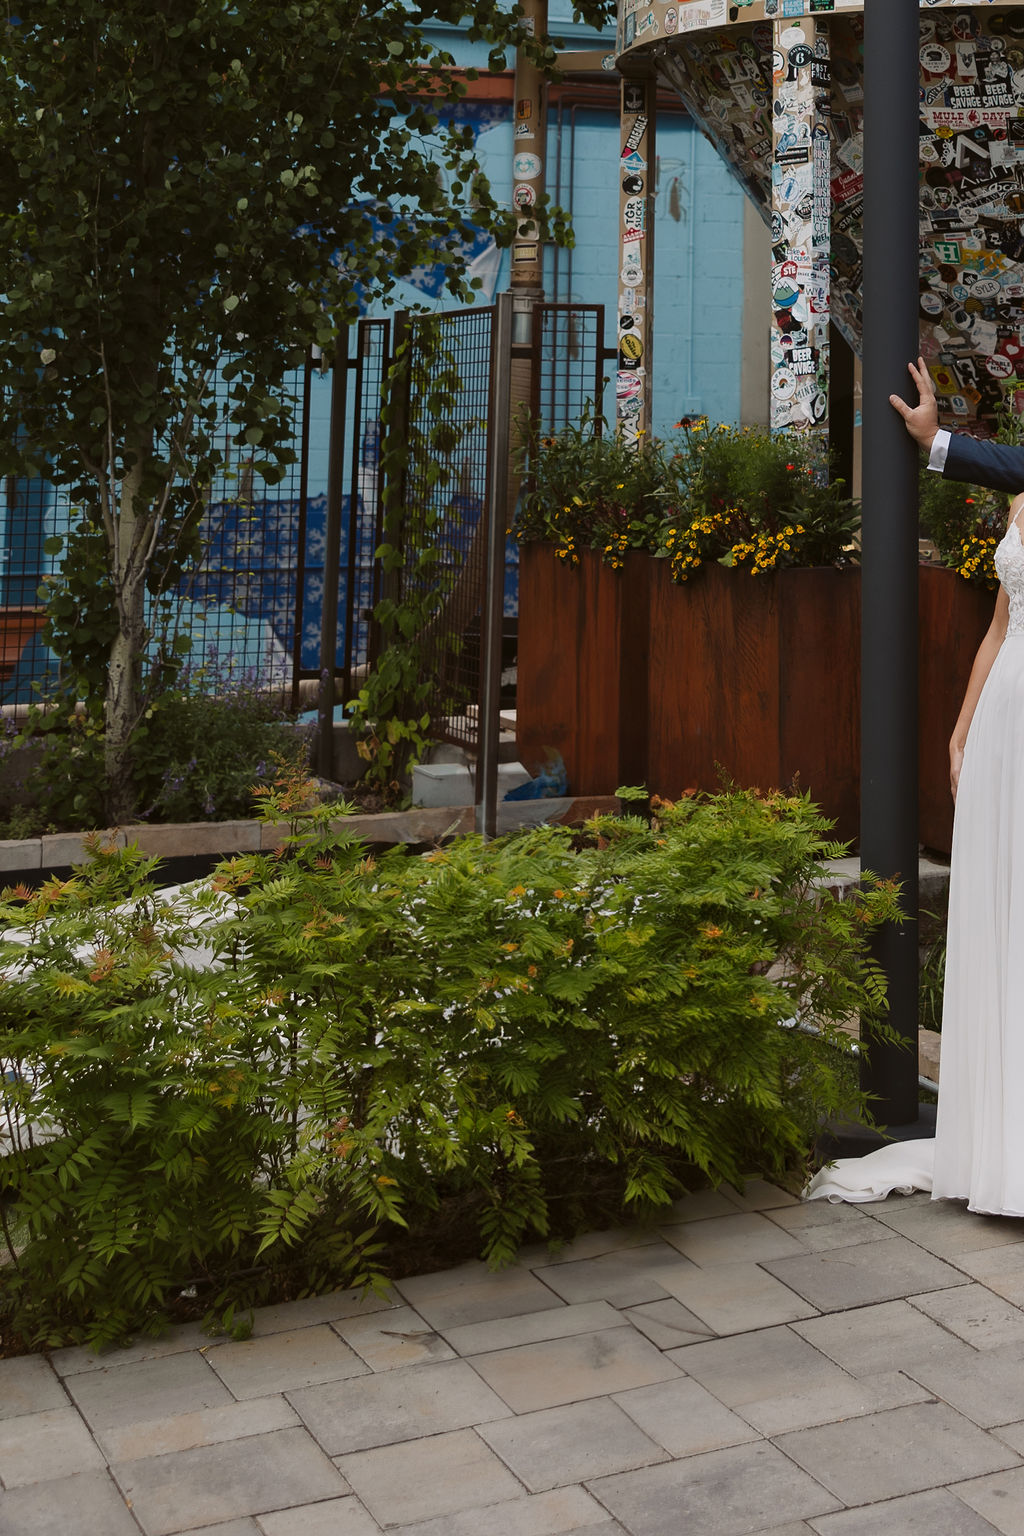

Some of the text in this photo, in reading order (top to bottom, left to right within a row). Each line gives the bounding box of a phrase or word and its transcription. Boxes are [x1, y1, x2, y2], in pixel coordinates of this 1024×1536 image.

[796, 52, 804, 64] 6
[953, 86, 975, 98] BEER
[985, 83, 1008, 95] BEER
[951, 97, 982, 109] SAVAGE
[982, 94, 1015, 107] SAVAGE
[933, 112, 1011, 120] MULE DAYS
[627, 115, 649, 150] GRAEAGLE
[626, 202, 636, 225] TGR
[635, 201, 643, 228] SUCKS
[975, 282, 996, 295] SYLR
[793, 349, 811, 362] BEER
